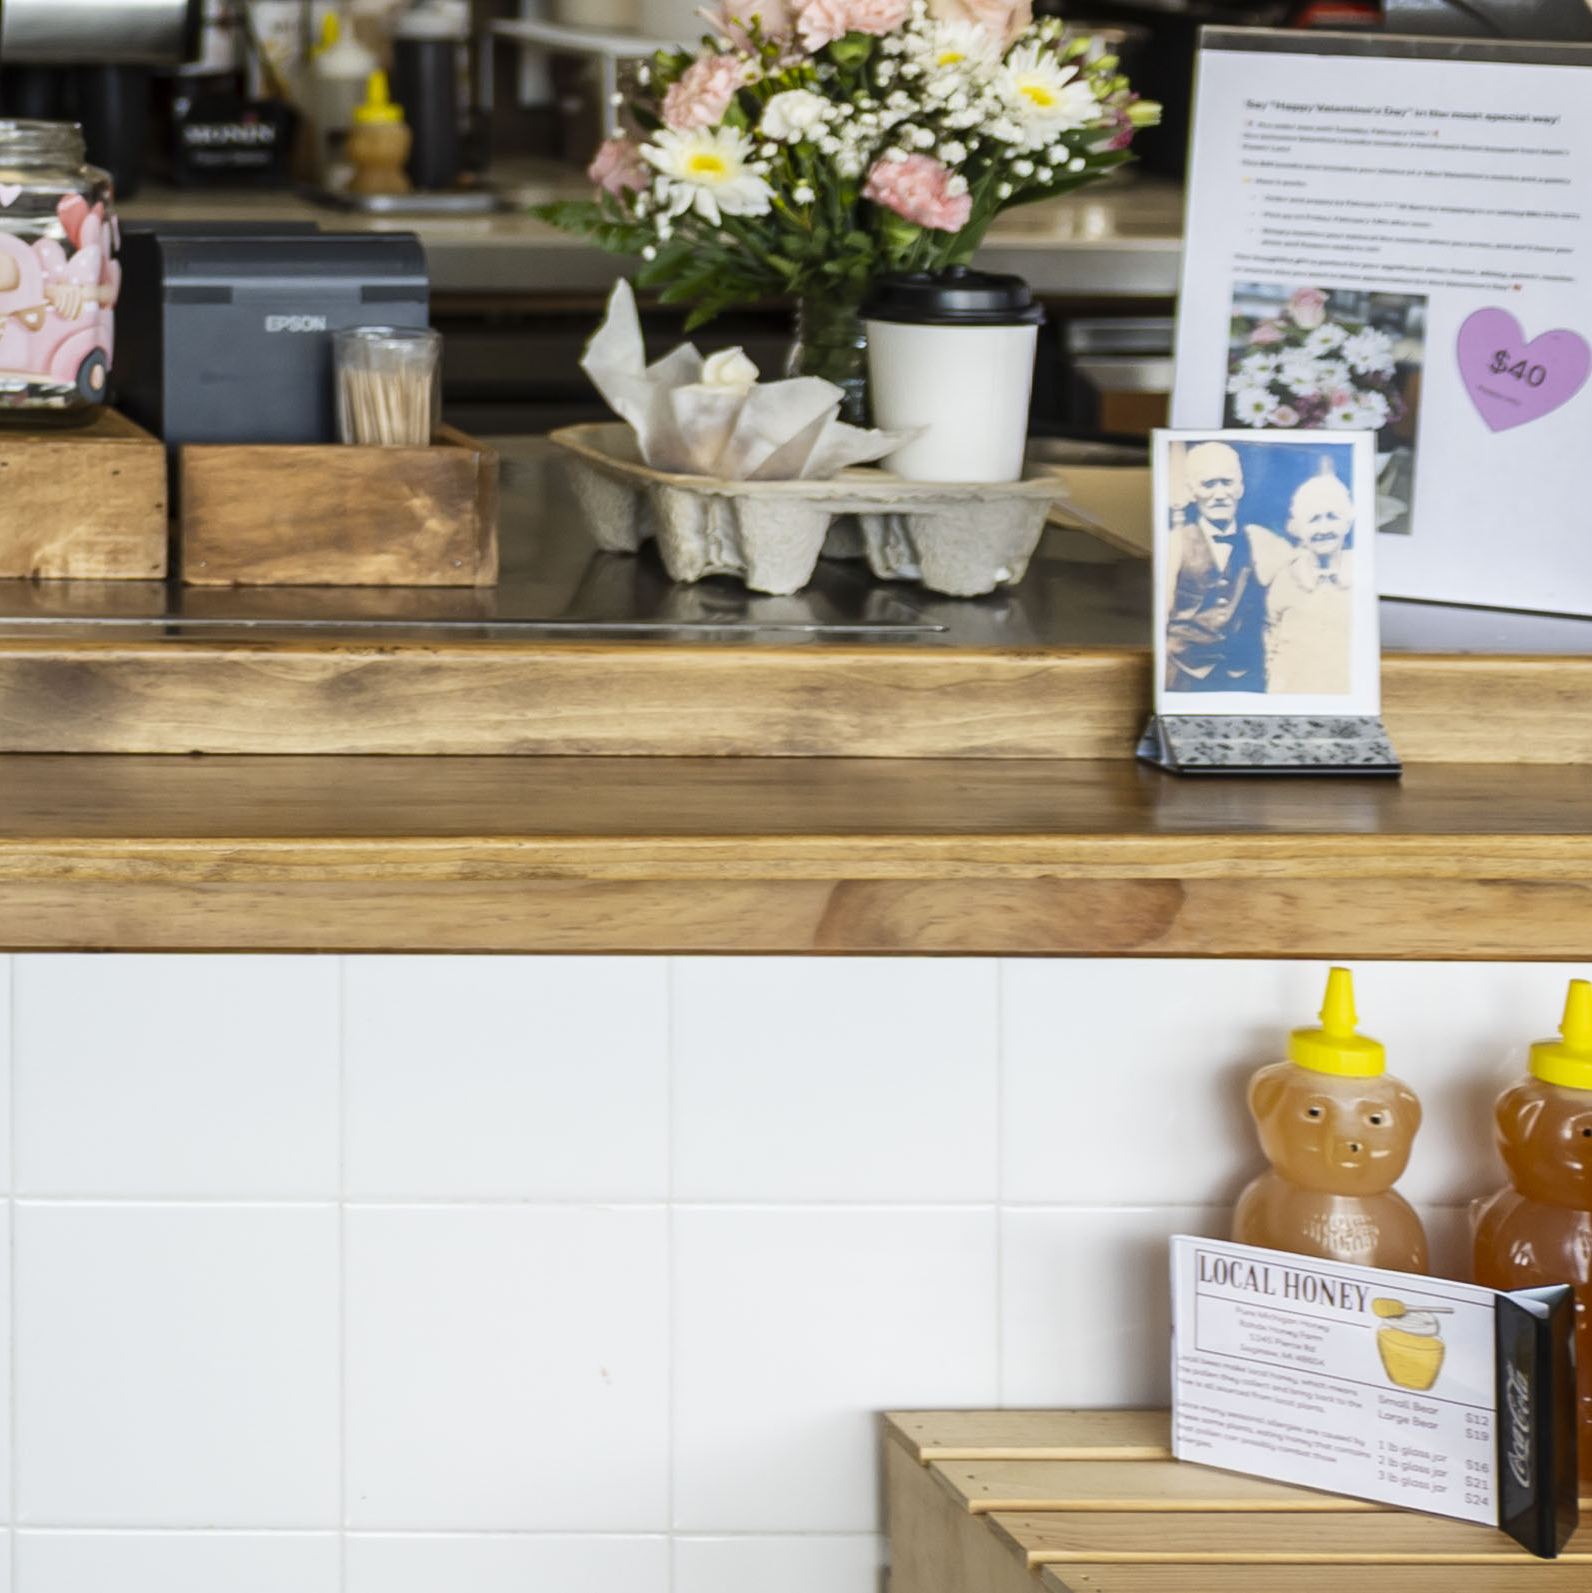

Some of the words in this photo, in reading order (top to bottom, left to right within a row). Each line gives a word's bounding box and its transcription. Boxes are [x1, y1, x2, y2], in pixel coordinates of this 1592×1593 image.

[265, 315, 327, 332] EPSON
[1488, 348, 1547, 388] $40
[1199, 1255, 1276, 1296] LOCAL
[1283, 1270, 1370, 1313] HONEY
[1377, 1394, 1411, 1410] Small
[1412, 1401, 1439, 1415] Bear
[1377, 1409, 1411, 1426] Large
[1412, 1415, 1439, 1430] Bear
